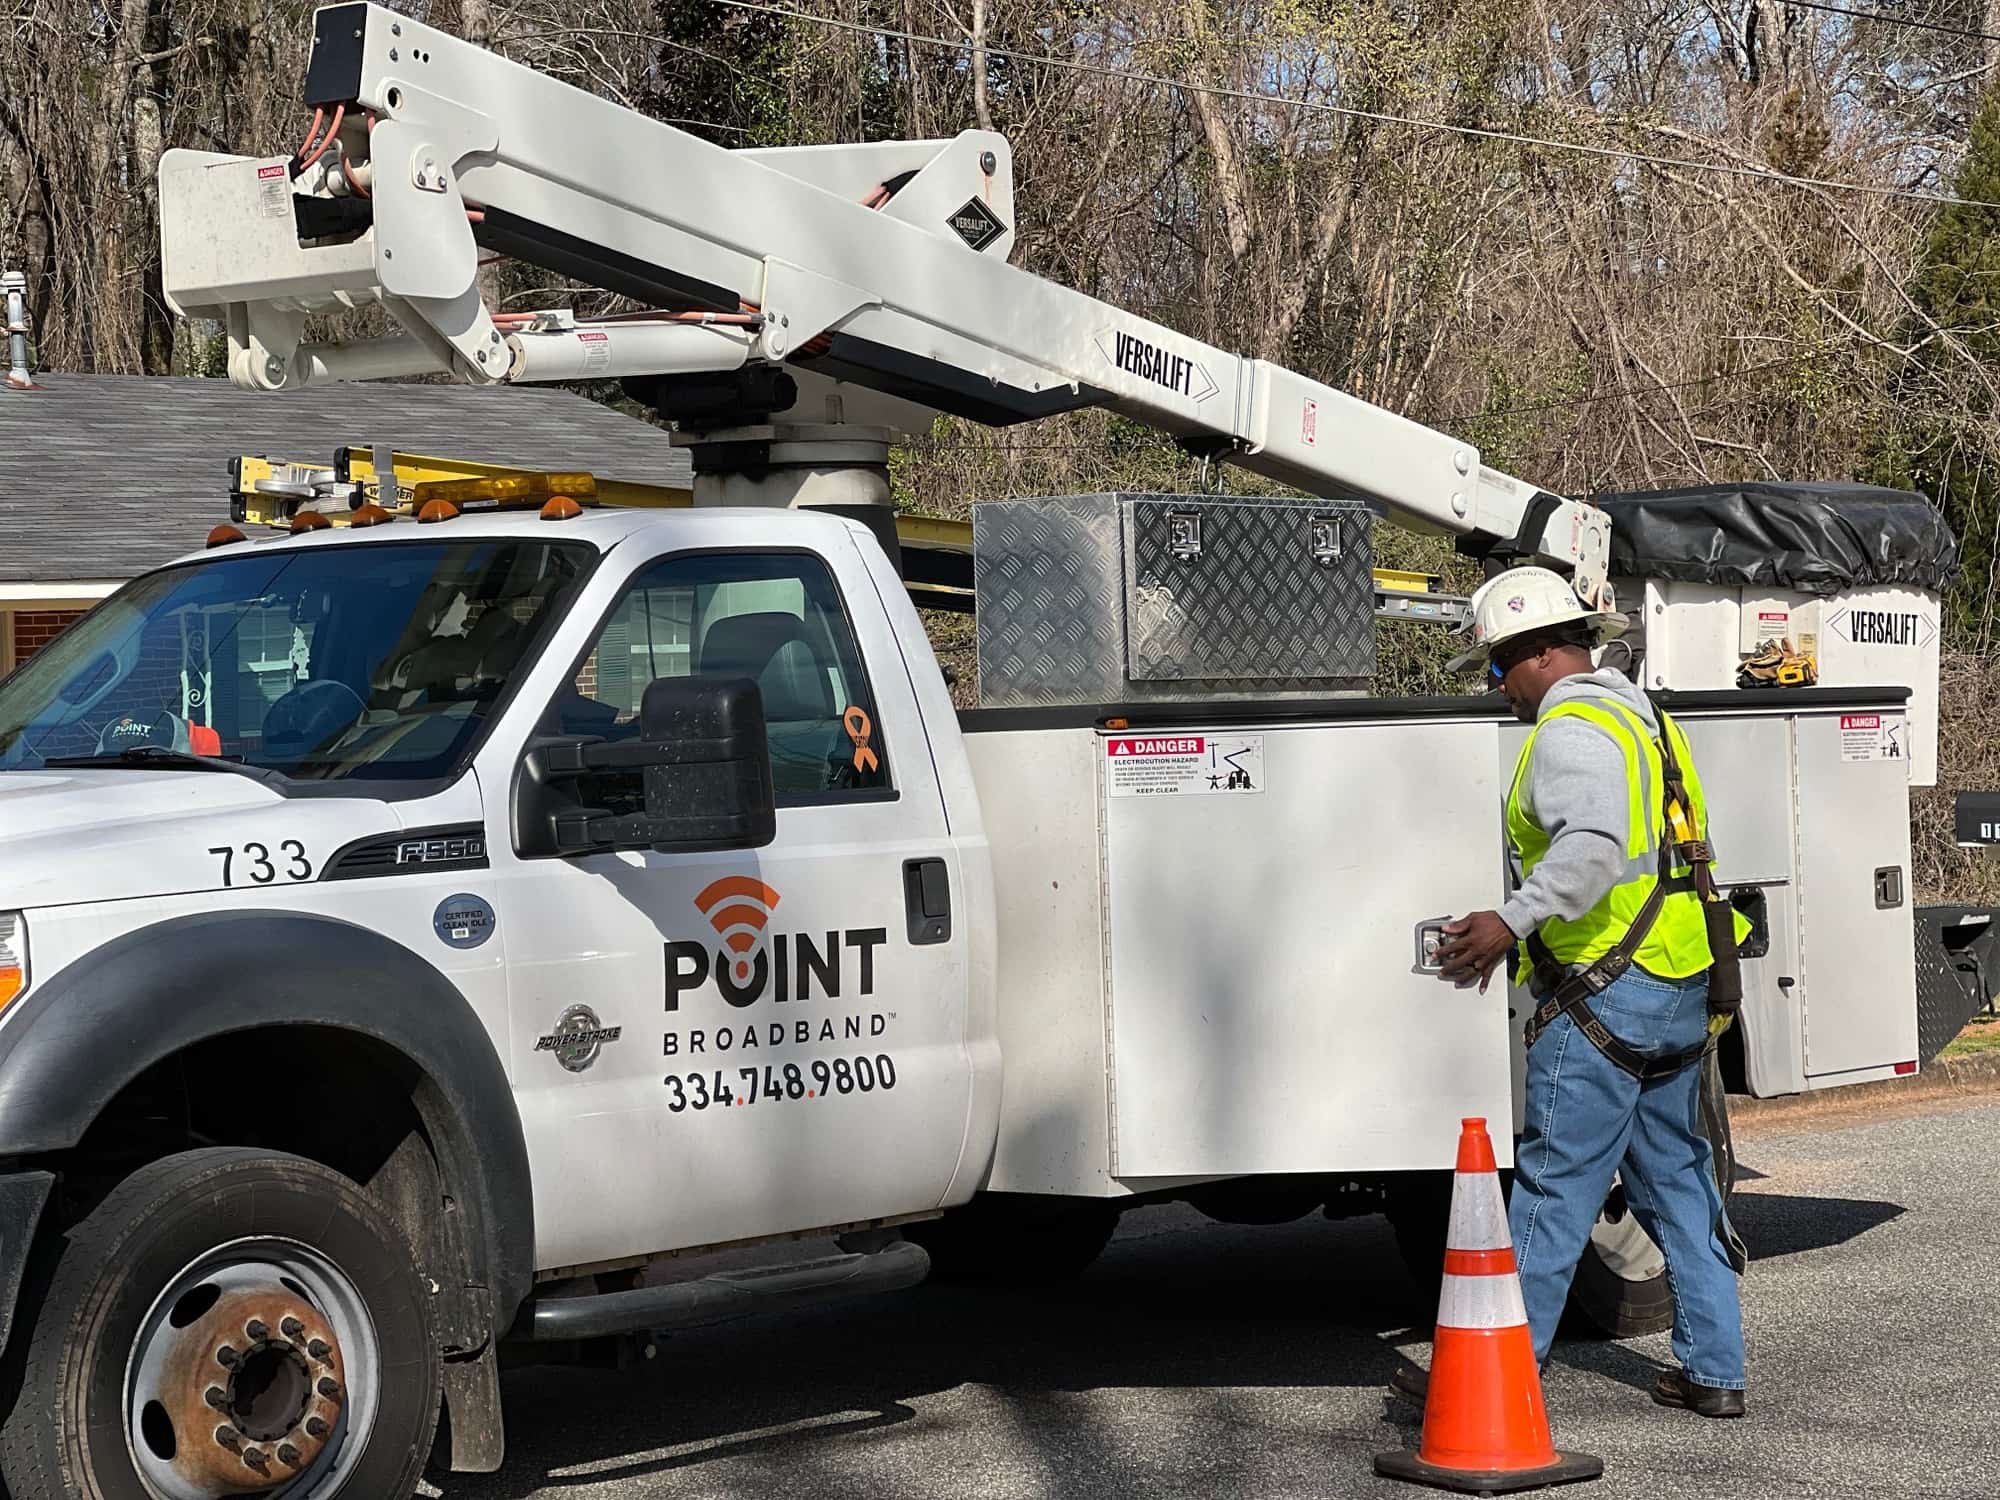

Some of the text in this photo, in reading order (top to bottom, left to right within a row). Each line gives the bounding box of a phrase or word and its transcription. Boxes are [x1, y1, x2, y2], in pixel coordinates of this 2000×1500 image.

[1116, 331, 1193, 396] VERSALIFT
[369, 487, 413, 500] WER
[1851, 611, 1919, 646] VERSALIFT
[114, 723, 152, 735] POINT
[1851, 717, 1878, 728] DANGER
[1135, 740, 1198, 754] DANGER
[208, 840, 312, 887] 733
[396, 839, 486, 865] F-550
[442, 918, 488, 930] CLEAN IDLE
[444, 910, 483, 921] CERTIFIED
[664, 928, 887, 1012] POINT
[535, 1026, 622, 1051] POWER STROKE
[663, 1014, 886, 1056] BROADBAND
[664, 1054, 897, 1113] 334.748.9800
